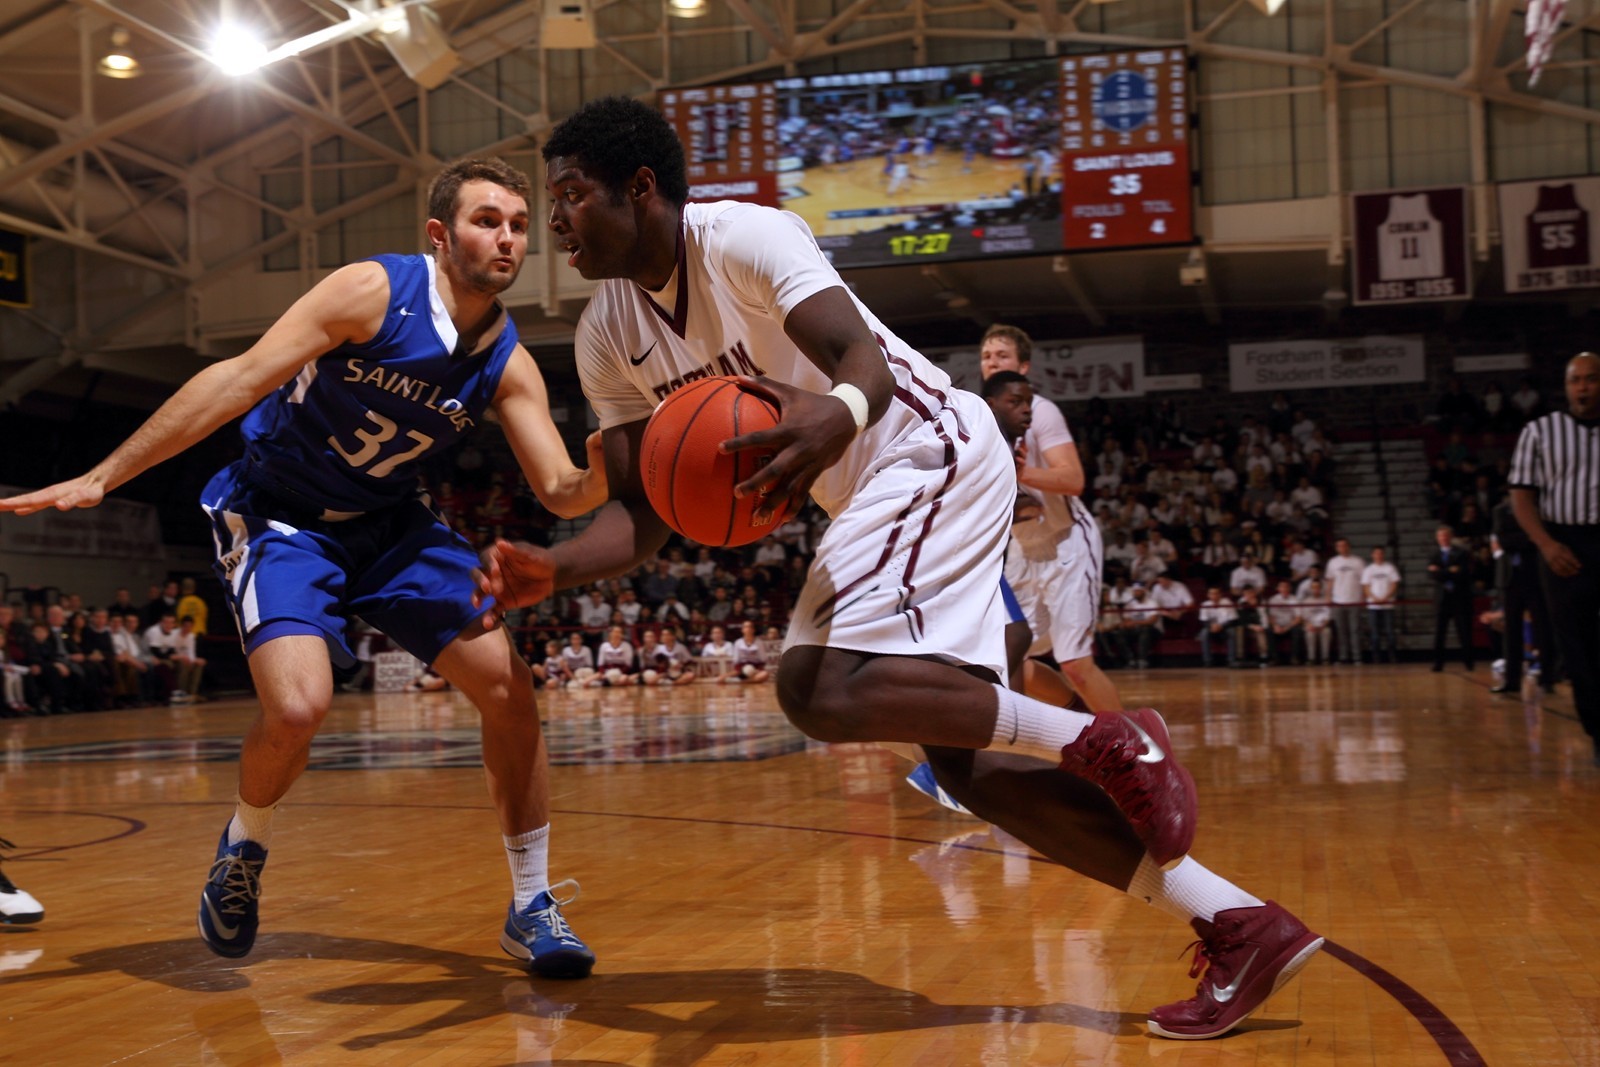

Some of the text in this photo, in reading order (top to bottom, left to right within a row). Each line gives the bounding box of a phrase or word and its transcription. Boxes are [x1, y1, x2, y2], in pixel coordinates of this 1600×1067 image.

[1072, 151, 1176, 171] SAINT LOUIS
[1109, 173, 1142, 195] 35
[889, 233, 952, 256] 17:27
[1400, 237, 1420, 259] 11
[1541, 224, 1577, 251] 55
[1246, 348, 1324, 367] Fordham
[343, 357, 430, 402] SAINT
[1256, 363, 1399, 385] Student Section
[327, 409, 436, 479] 37
